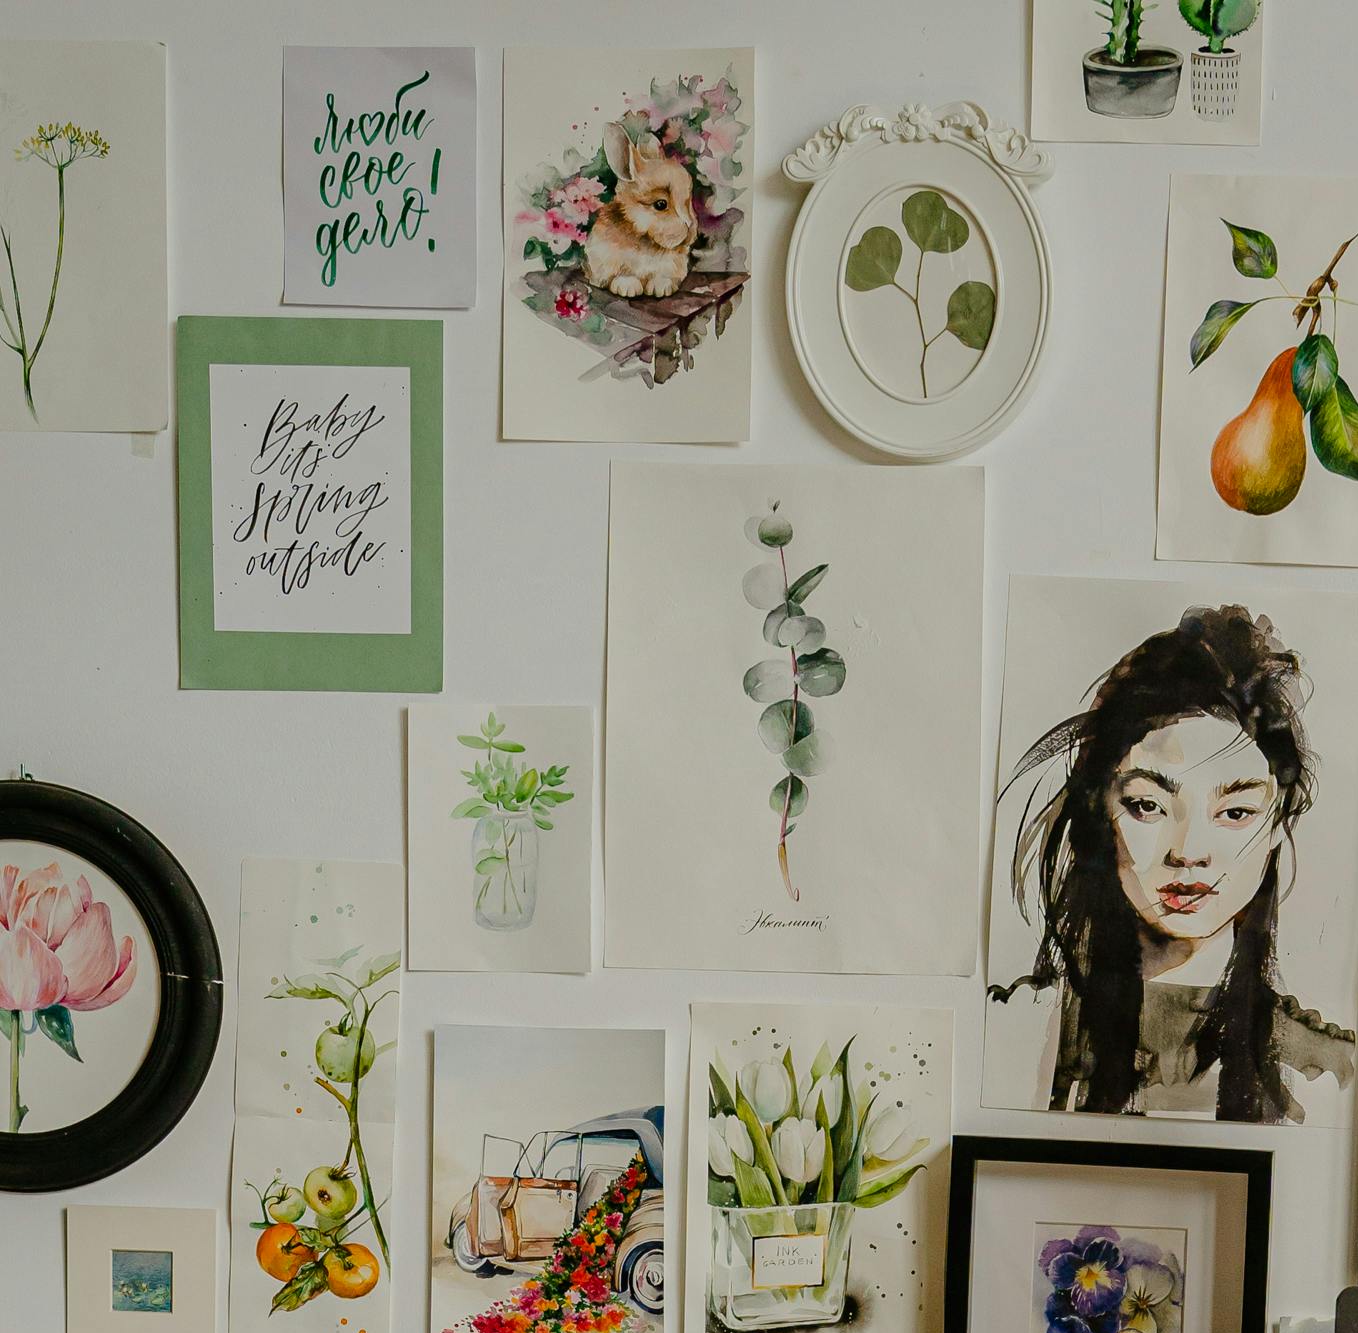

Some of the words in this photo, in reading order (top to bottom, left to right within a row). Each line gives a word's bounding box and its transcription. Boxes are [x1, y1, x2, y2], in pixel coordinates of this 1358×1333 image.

[319, 151, 416, 208] свое
[250, 393, 385, 475] Baby
[246, 531, 387, 595] outside
[762, 1257, 814, 1268] GARDEN
[776, 1245, 801, 1257] INK
